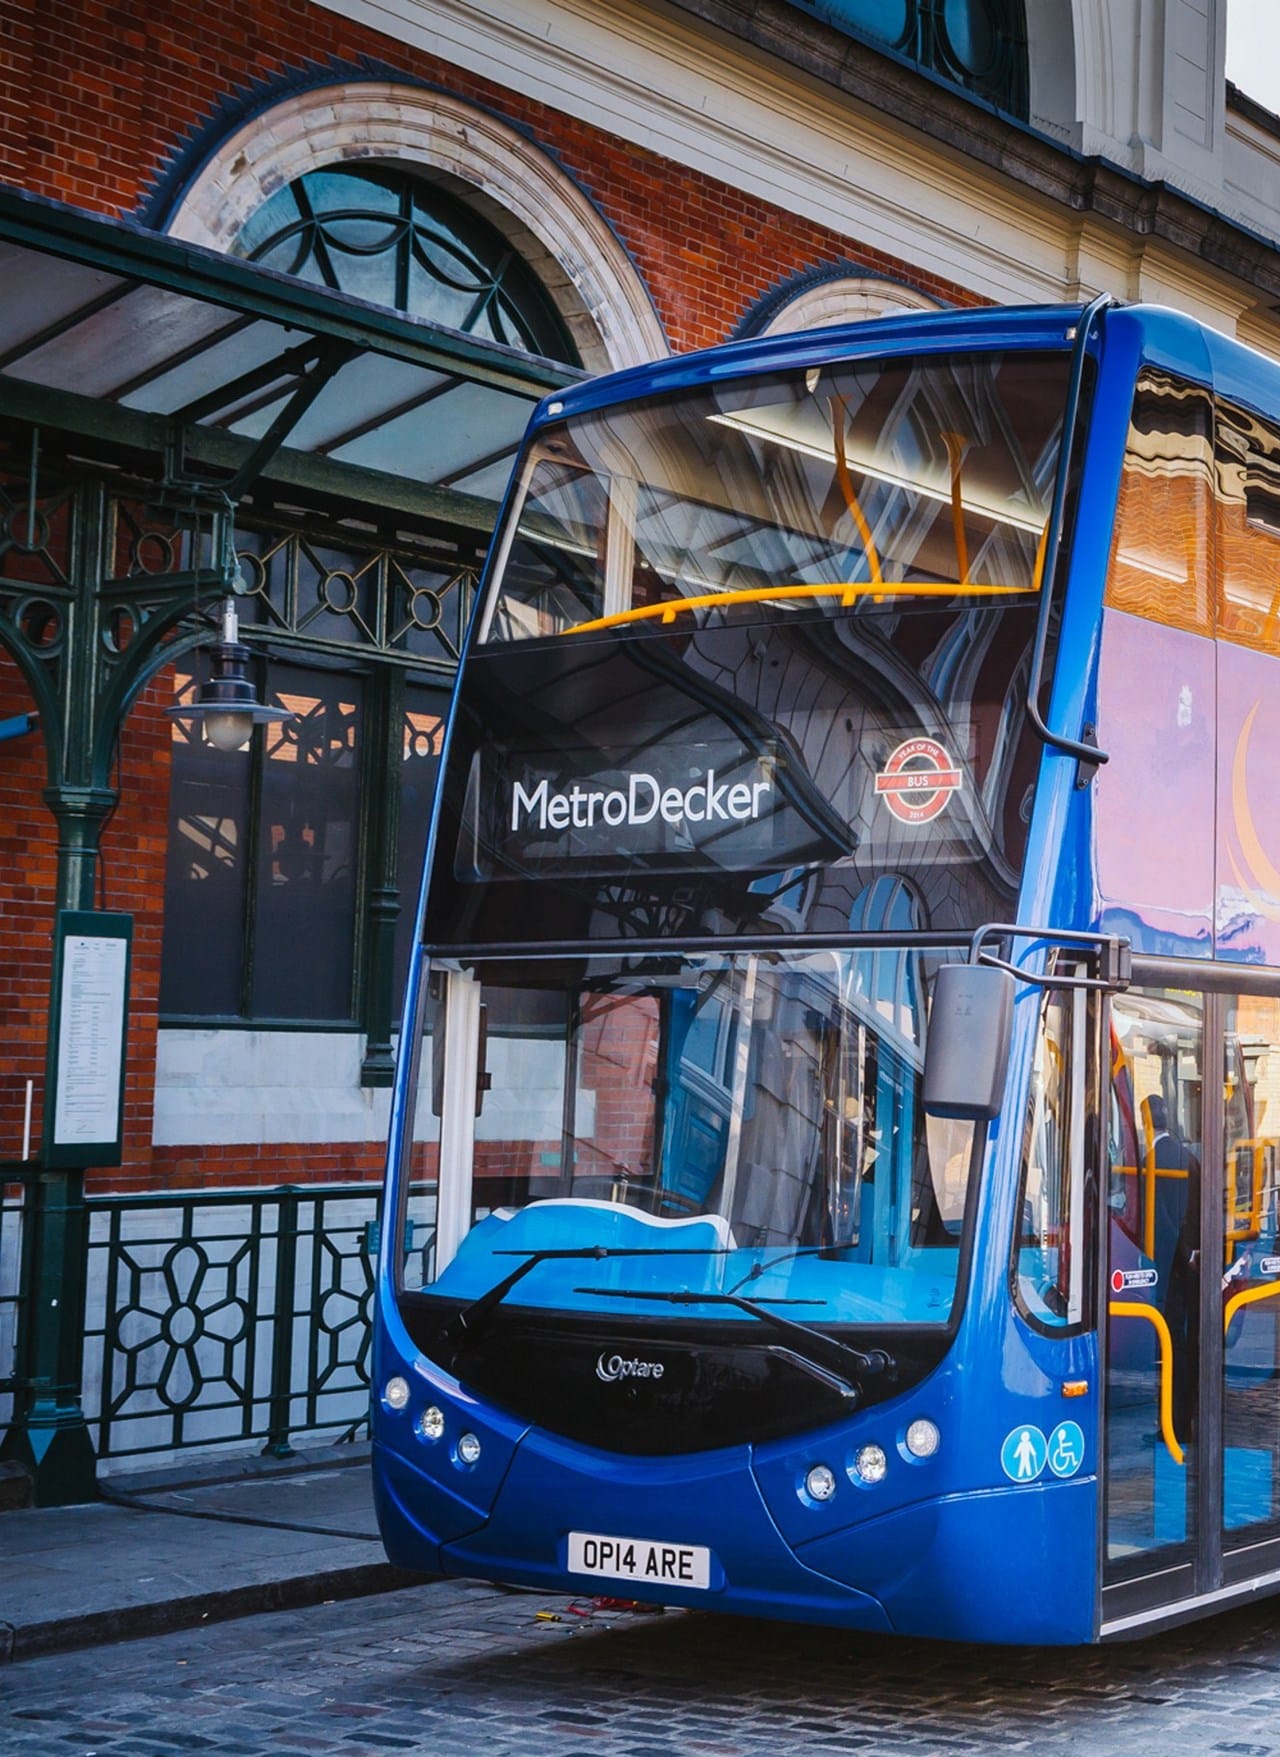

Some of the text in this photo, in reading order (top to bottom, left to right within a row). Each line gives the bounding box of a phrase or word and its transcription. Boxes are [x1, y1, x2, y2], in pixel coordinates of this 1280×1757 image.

[908, 776, 928, 787] BUS
[511, 769, 770, 831] MetroDecker
[607, 1354, 665, 1381] Optare
[583, 1539, 694, 1580] OP14 ARE
